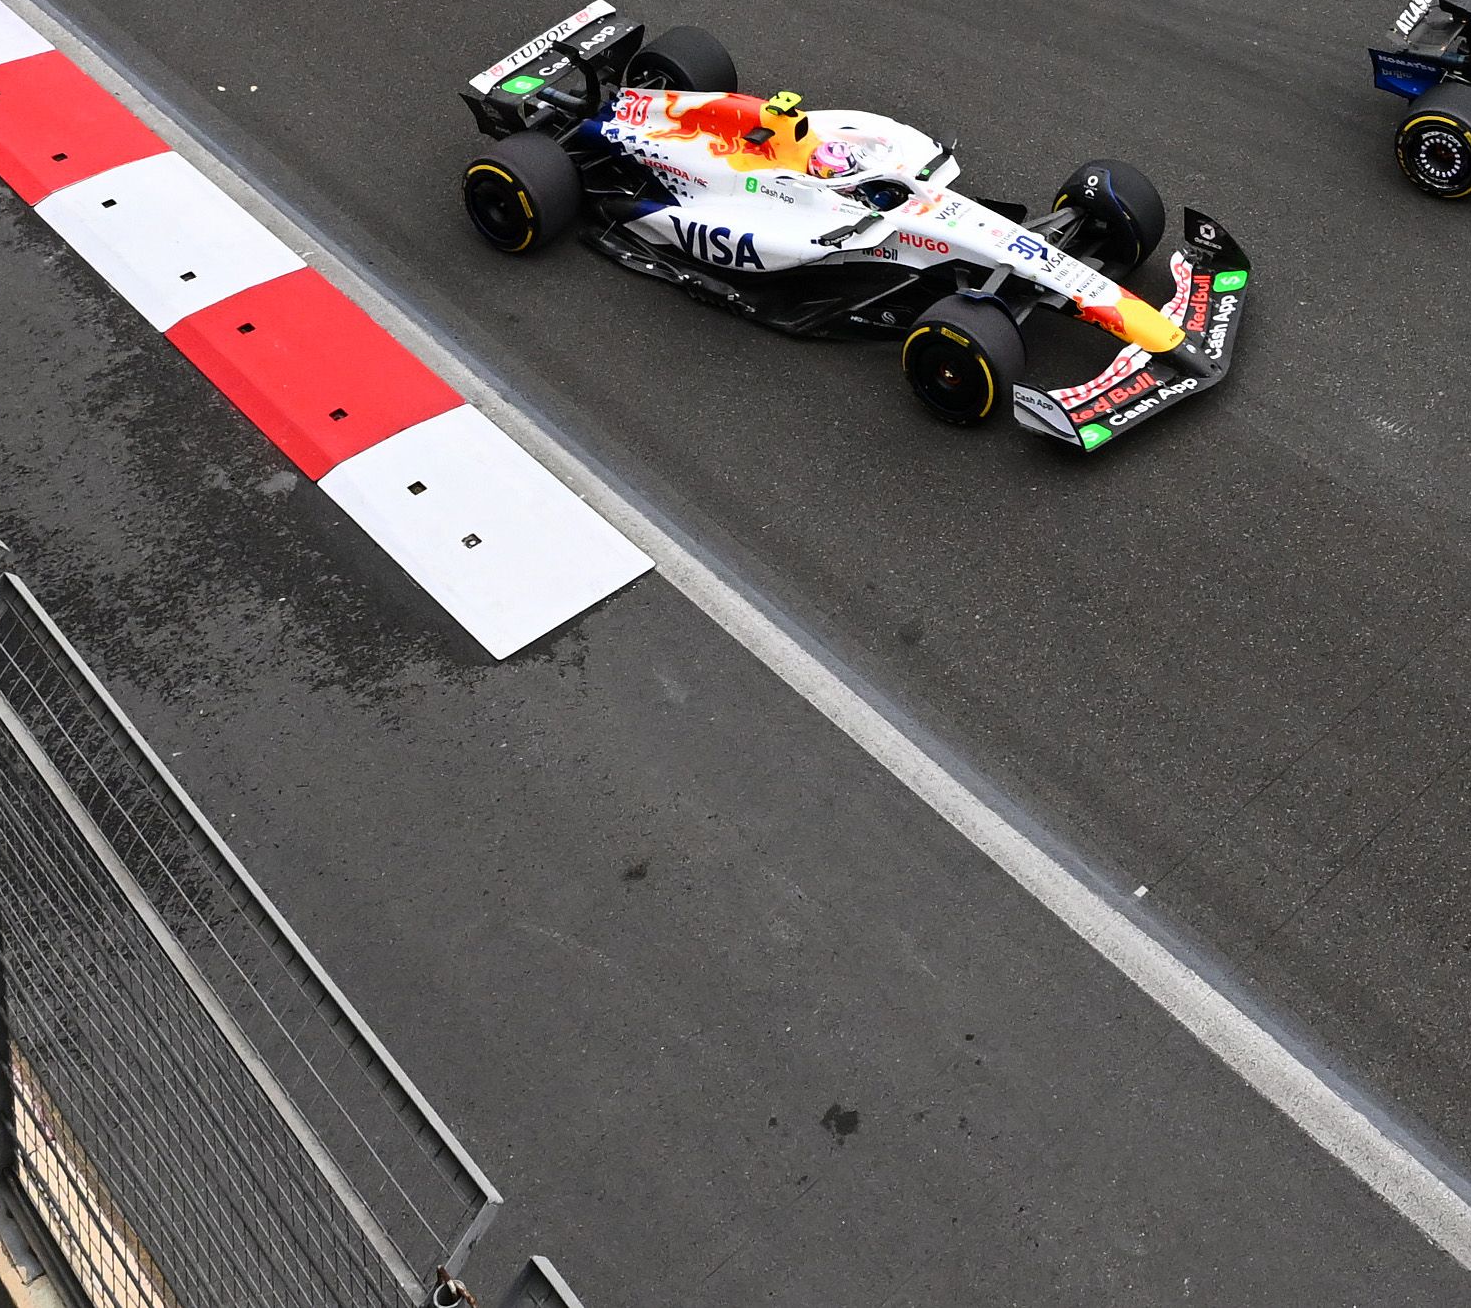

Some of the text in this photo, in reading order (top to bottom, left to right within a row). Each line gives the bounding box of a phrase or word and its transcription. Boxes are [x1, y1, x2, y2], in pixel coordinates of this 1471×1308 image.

[507, 21, 572, 67] TUDOR
[580, 24, 617, 52] App
[617, 90, 653, 125] 30
[643, 158, 690, 181] HONDA
[760, 185, 794, 204] Cash App
[934, 200, 963, 221] VISA
[669, 214, 765, 270] VISA
[899, 232, 950, 254] HUGO
[1007, 234, 1044, 261] 30
[1041, 251, 1068, 274] VISA
[1215, 294, 1238, 325] App
[1015, 391, 1054, 411] Cash App
[1108, 377, 1198, 426] Cash App
[1110, 373, 1156, 410] Bull
